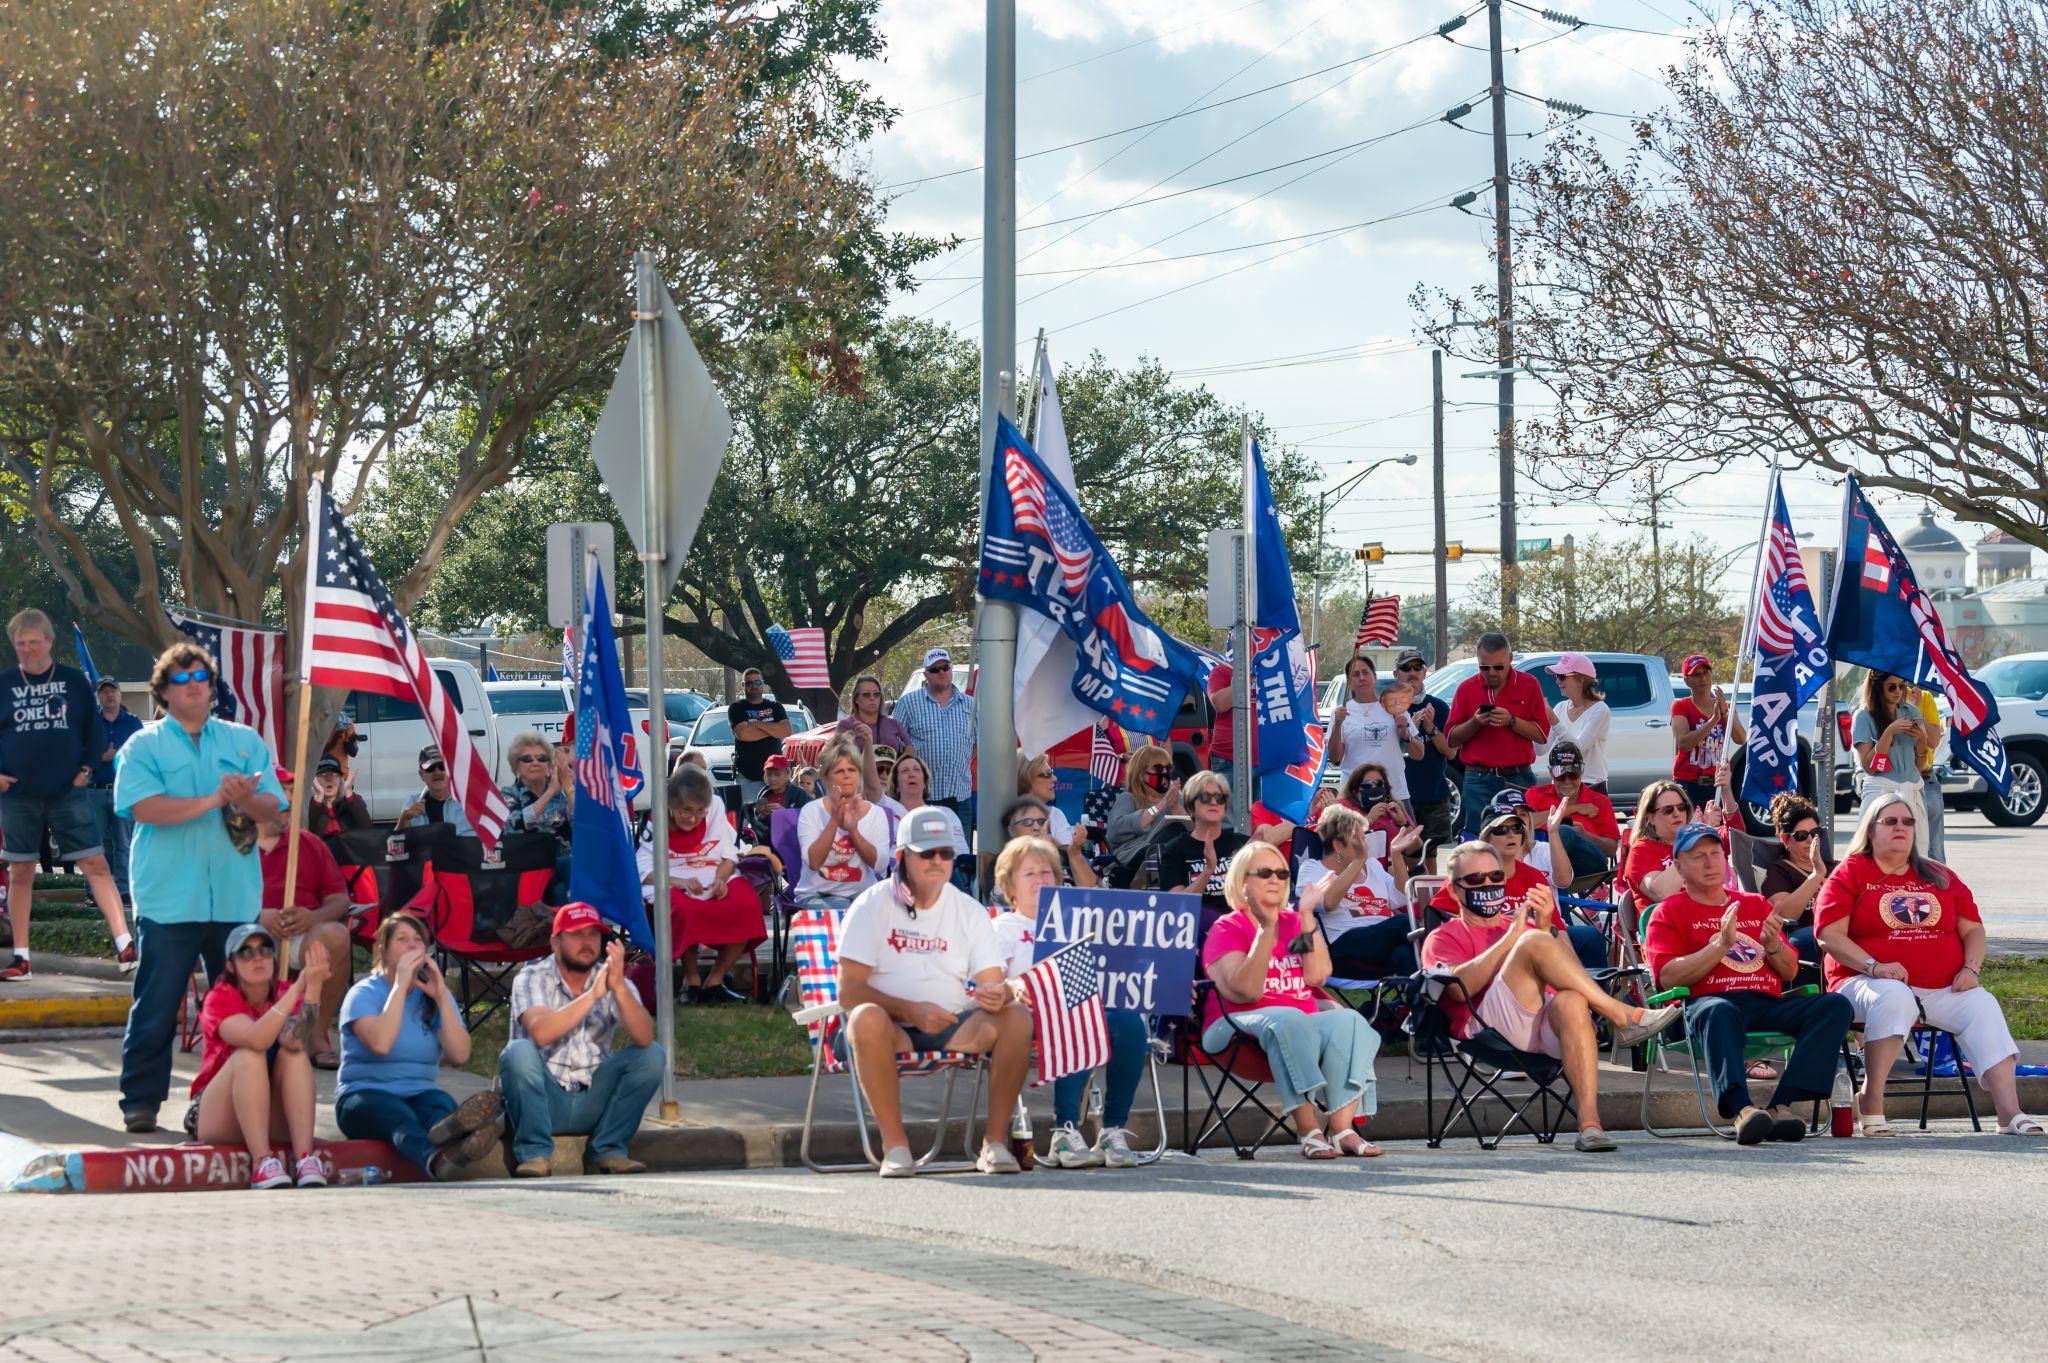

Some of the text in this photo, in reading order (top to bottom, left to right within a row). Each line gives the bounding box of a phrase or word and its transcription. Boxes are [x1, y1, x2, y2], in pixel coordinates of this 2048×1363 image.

[500, 671, 552, 681] Kevin Laine
[11, 681, 67, 699] WHERE
[1263, 671, 1292, 724] THE
[12, 698, 44, 708] WE GO
[13, 707, 45, 723] ONE
[15, 723, 30, 732] WE
[34, 721, 50, 730] GO
[1471, 888, 1505, 901] TRUMP
[1036, 889, 1196, 950] America
[1736, 919, 1761, 929] RUMP
[1092, 945, 1159, 1011] irst
[124, 1153, 175, 1187] NO
